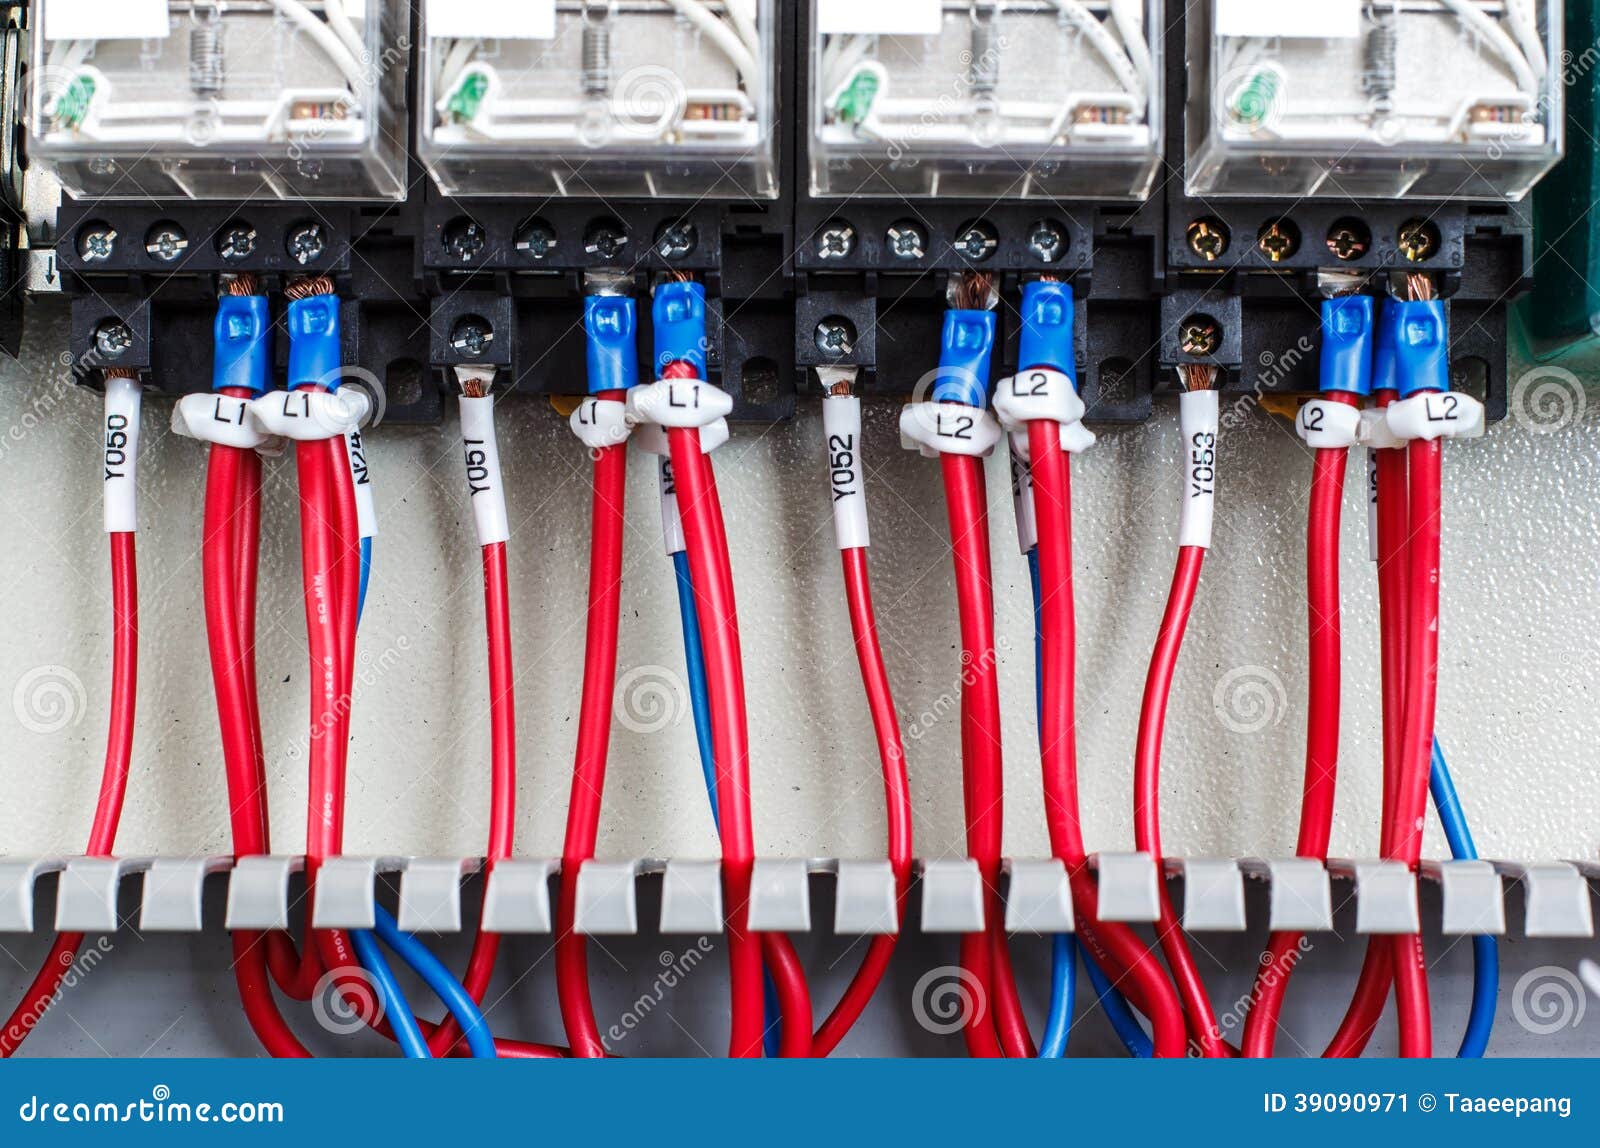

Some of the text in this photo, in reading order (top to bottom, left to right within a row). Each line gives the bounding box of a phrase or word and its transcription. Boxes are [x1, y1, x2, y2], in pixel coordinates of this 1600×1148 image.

[669, 385, 700, 409] L1
[1012, 373, 1049, 397] L2
[214, 397, 246, 426] L1
[283, 393, 310, 418] L1
[578, 401, 597, 425] L1
[1301, 406, 1325, 432] L2
[1426, 395, 1458, 421] L2
[936, 412, 974, 440] L2
[105, 414, 128, 481] Y050
[351, 432, 369, 485] N24
[464, 439, 490, 497] Y051
[829, 434, 856, 502] Y052
[1192, 431, 1215, 498] Y053
